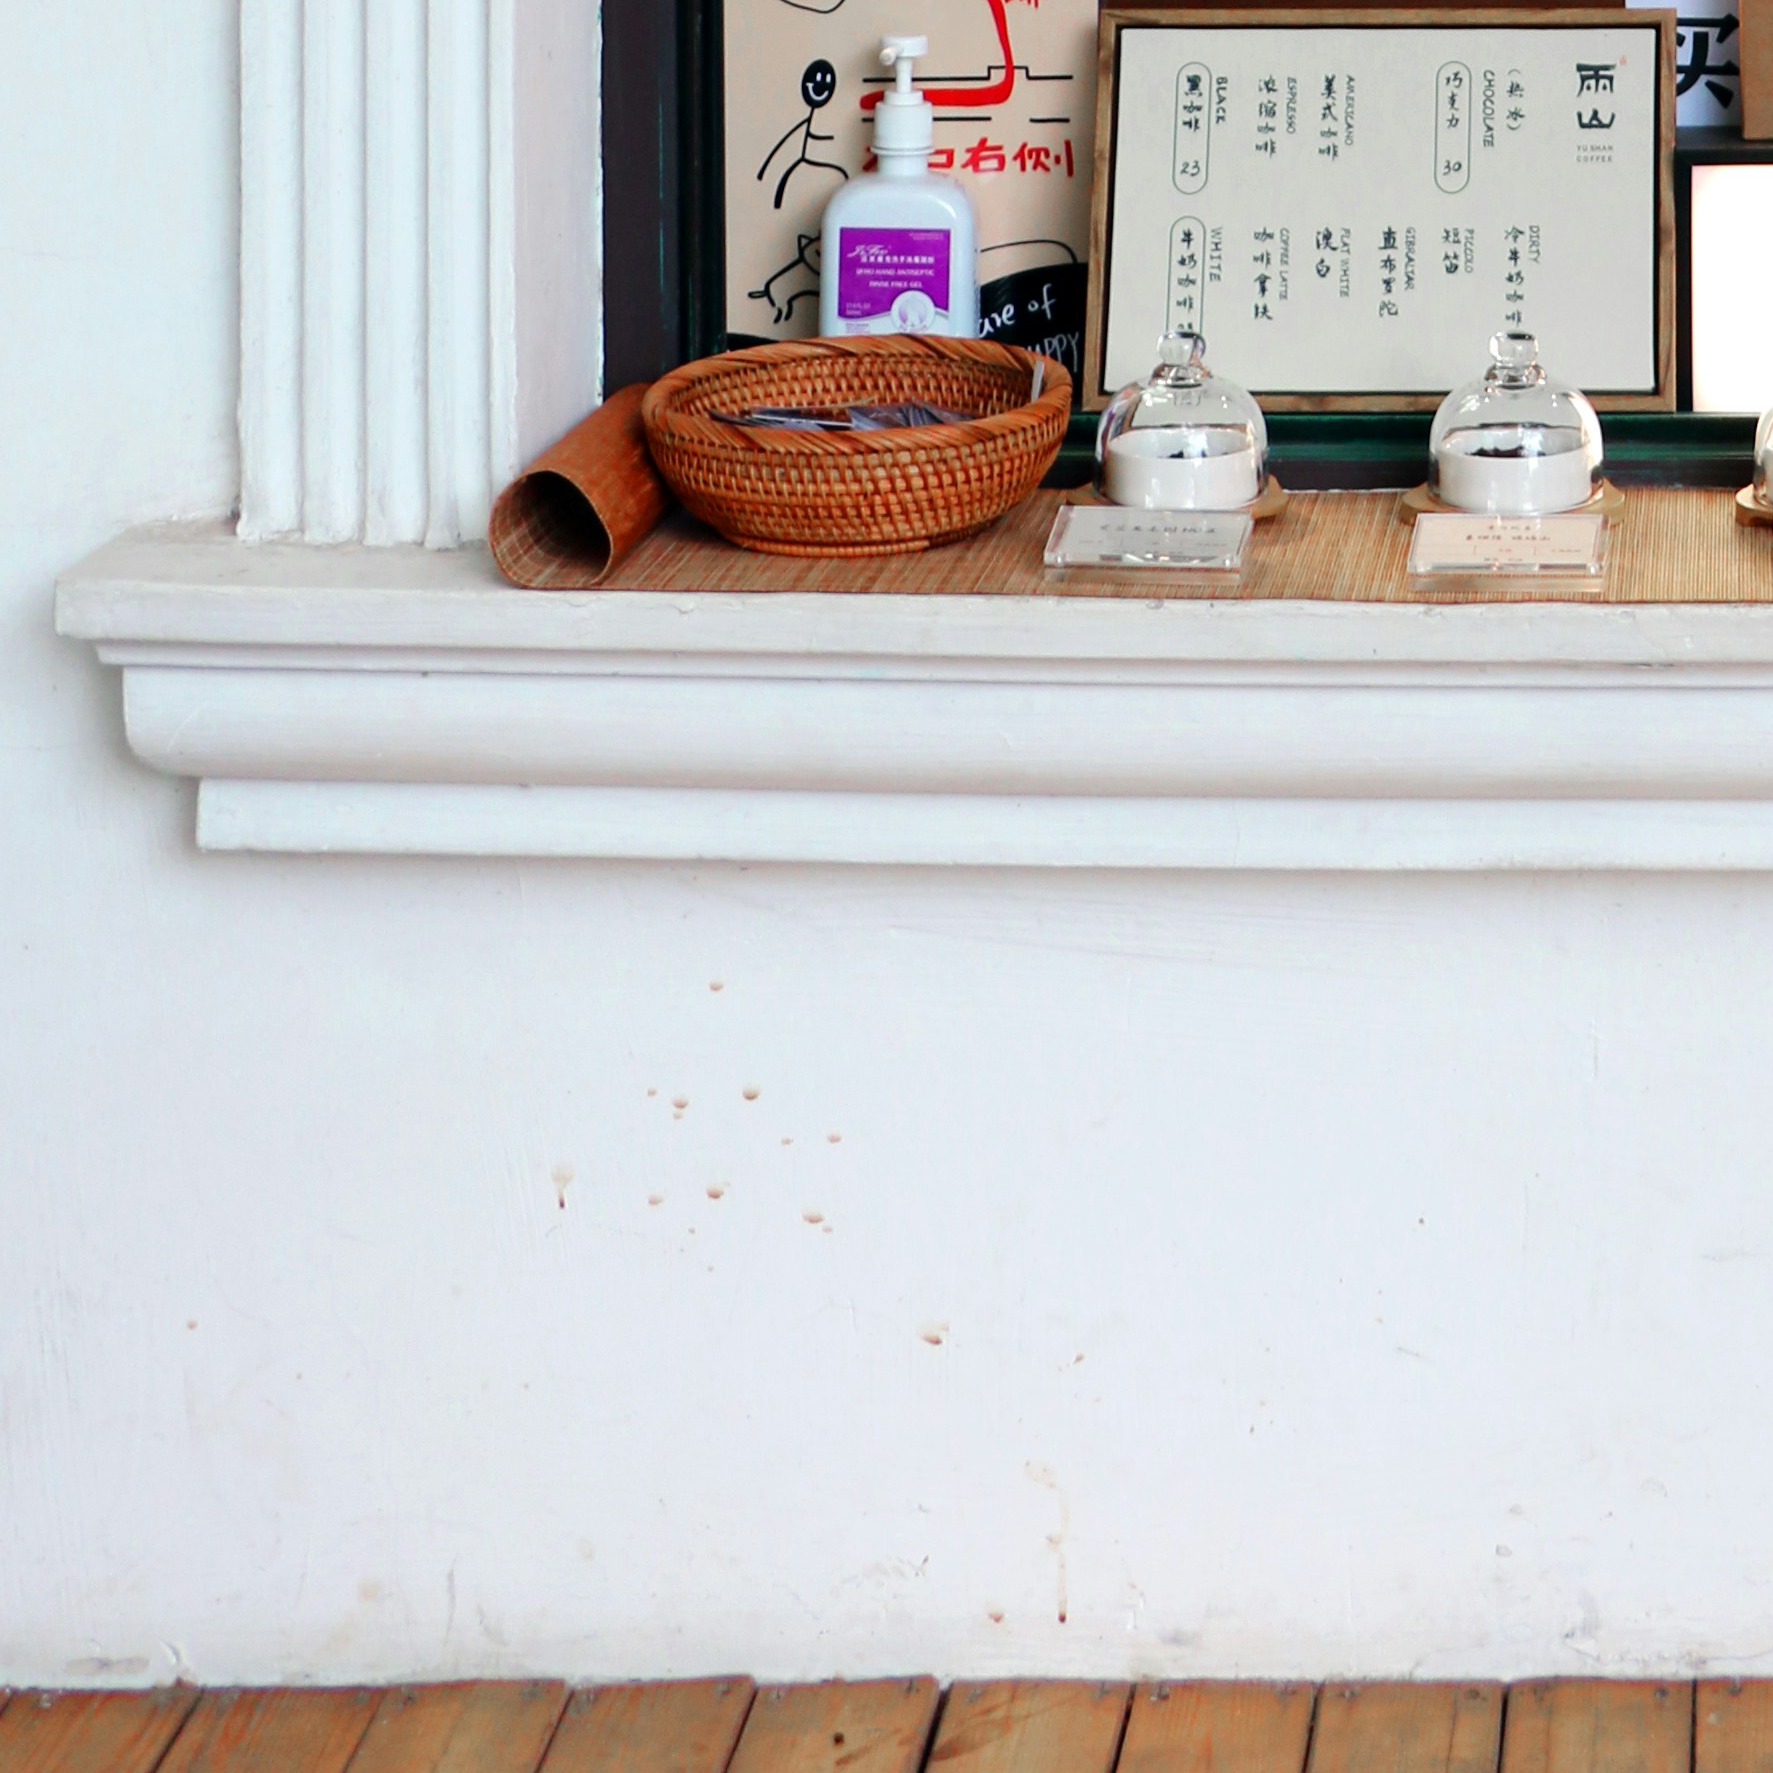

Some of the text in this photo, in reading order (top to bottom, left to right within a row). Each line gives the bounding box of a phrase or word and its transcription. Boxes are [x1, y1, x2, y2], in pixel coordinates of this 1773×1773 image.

[1215, 76, 1228, 125] BLACK
[1285, 76, 1297, 135] ESPRESSO
[1343, 73, 1356, 146] AMERICANO
[1482, 69, 1496, 148] CHOCOLATE
[1575, 63, 1616, 129] 雨山
[862, 136, 1074, 178] 口右侧
[1179, 159, 1201, 177] 23
[1442, 159, 1463, 176] 30
[1209, 226, 1223, 283] WHITE
[1339, 227, 1351, 298] FLAT WHITE
[1528, 224, 1541, 264] DIRTY
[1027, 283, 1056, 321] of
